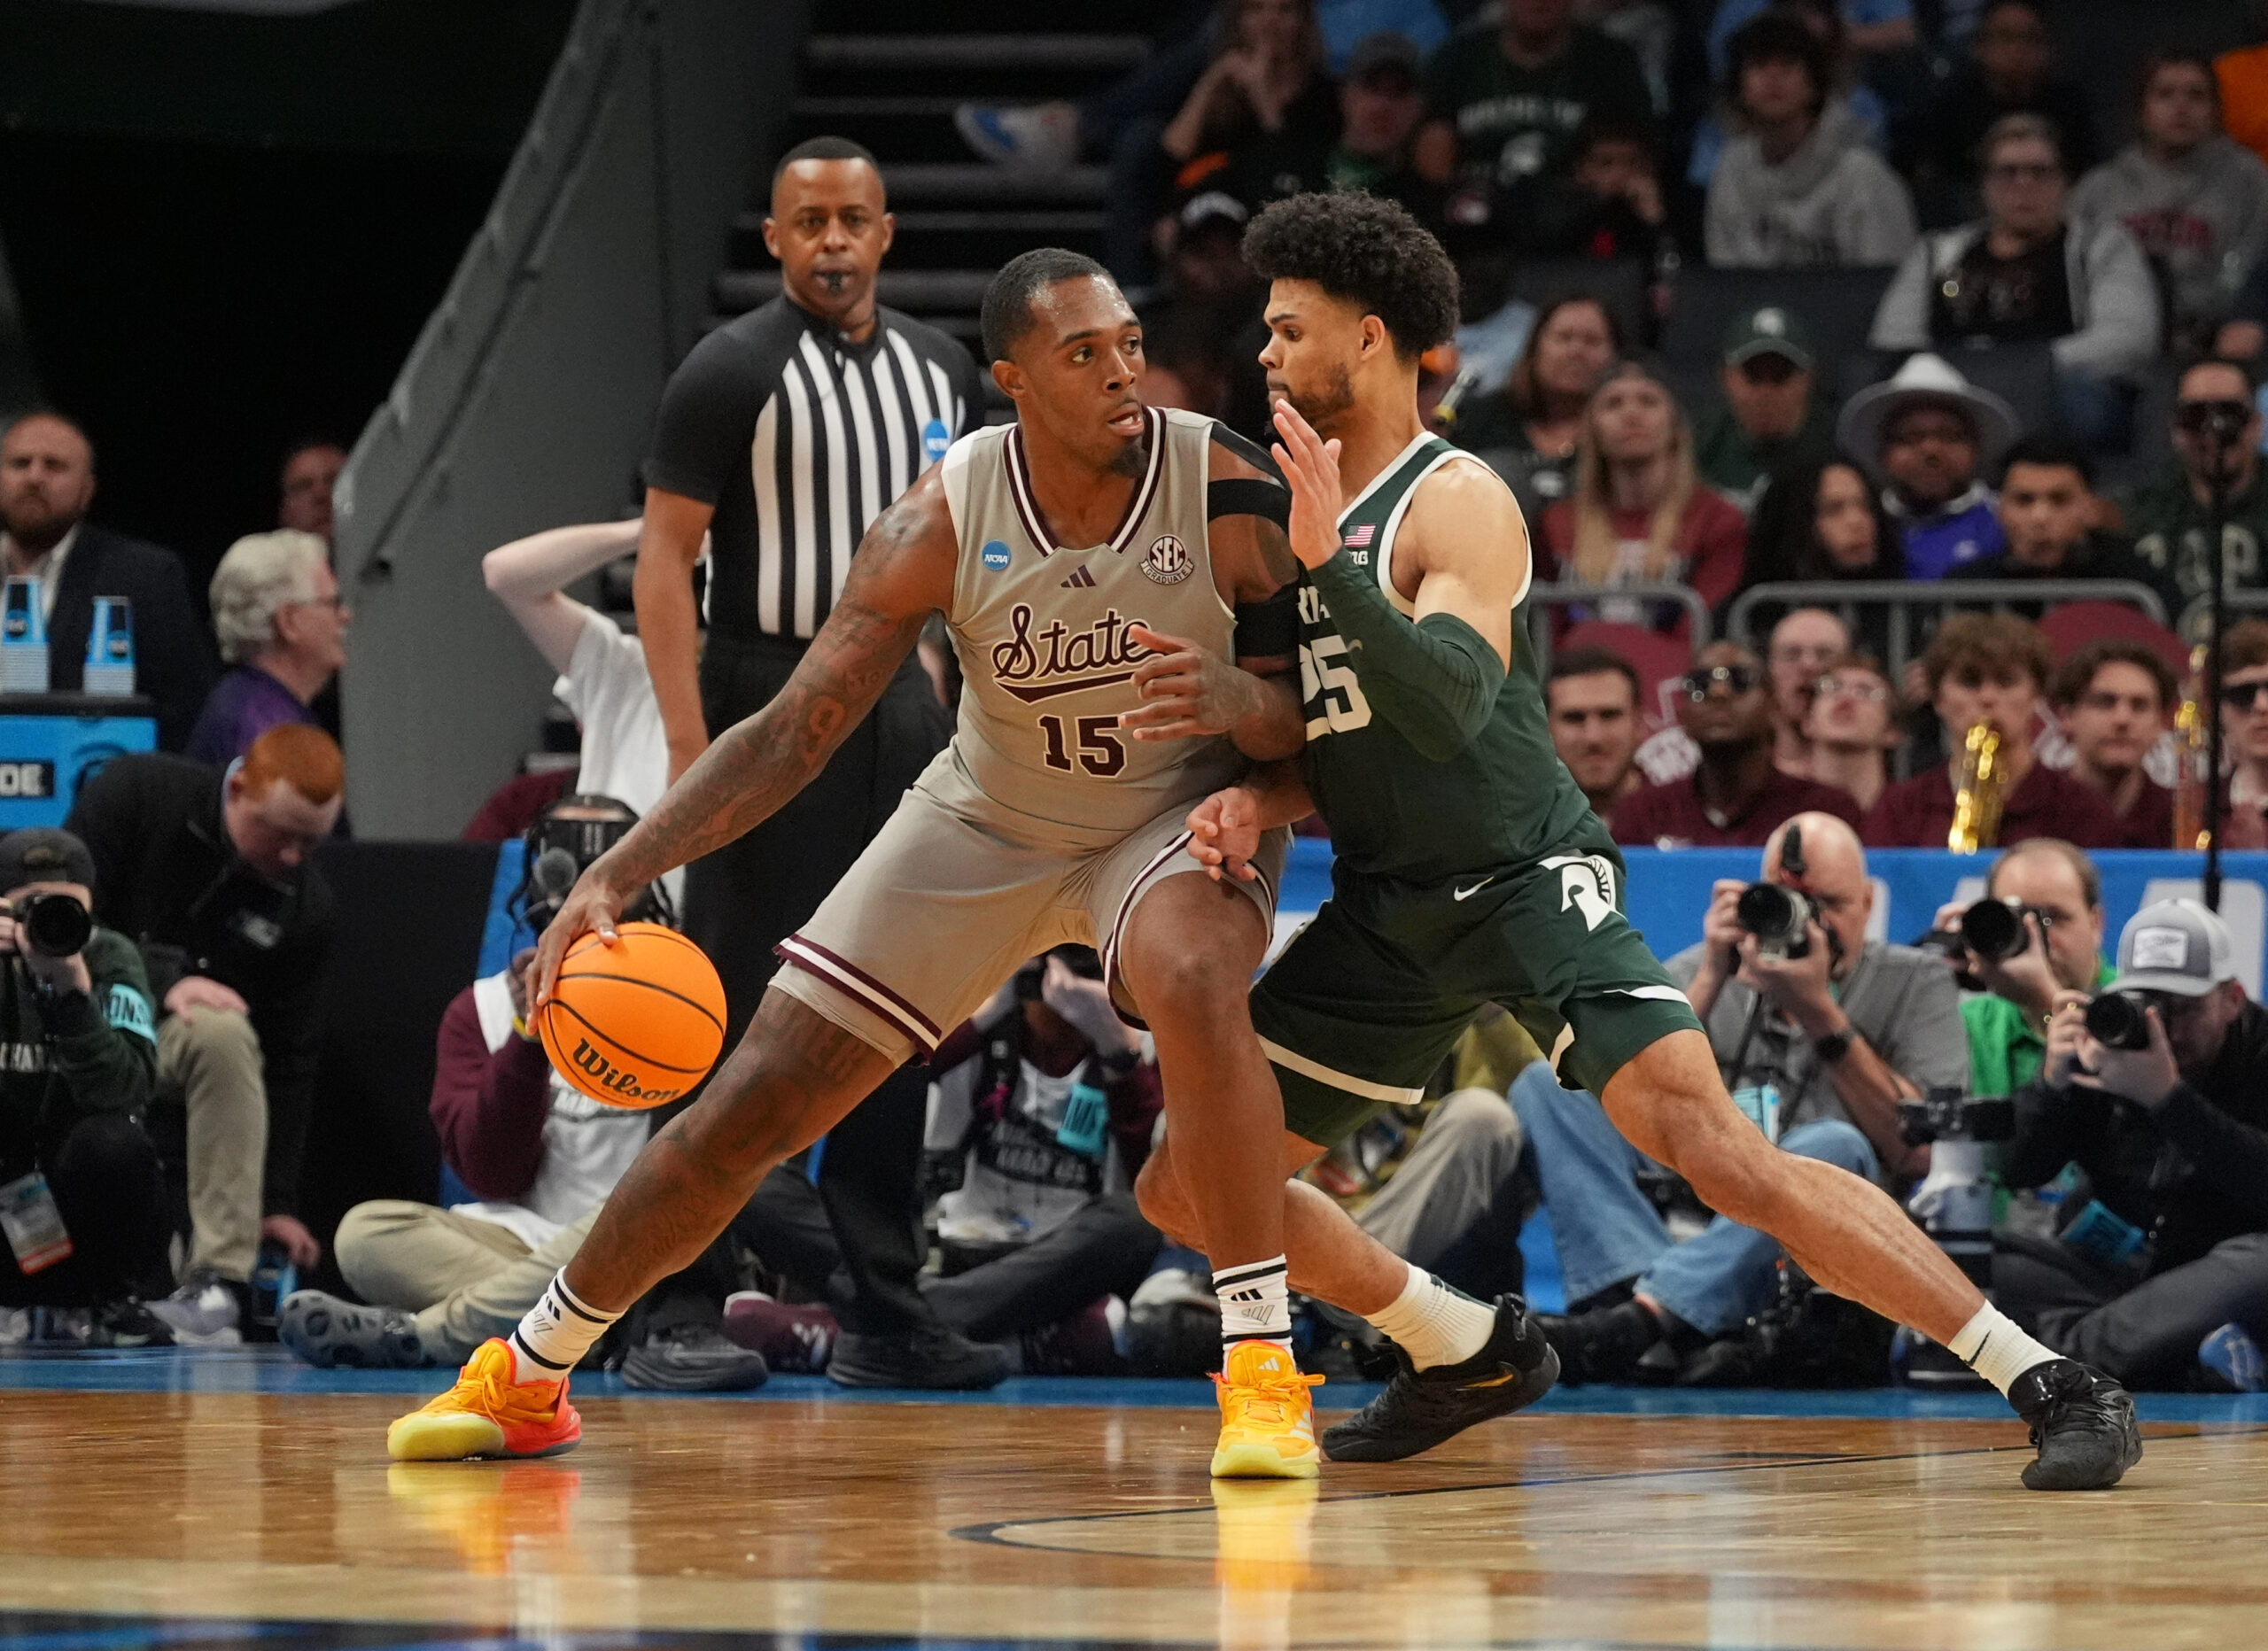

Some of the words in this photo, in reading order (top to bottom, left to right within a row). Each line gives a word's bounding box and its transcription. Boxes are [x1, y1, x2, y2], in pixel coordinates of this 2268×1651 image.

[984, 554, 1008, 564] NCAA
[1146, 568, 1189, 585] GRADUATE
[1151, 536, 1184, 572] SEC
[990, 601, 1166, 682] State
[1037, 713, 1128, 779] 15
[572, 1036, 681, 1101] Wilson
